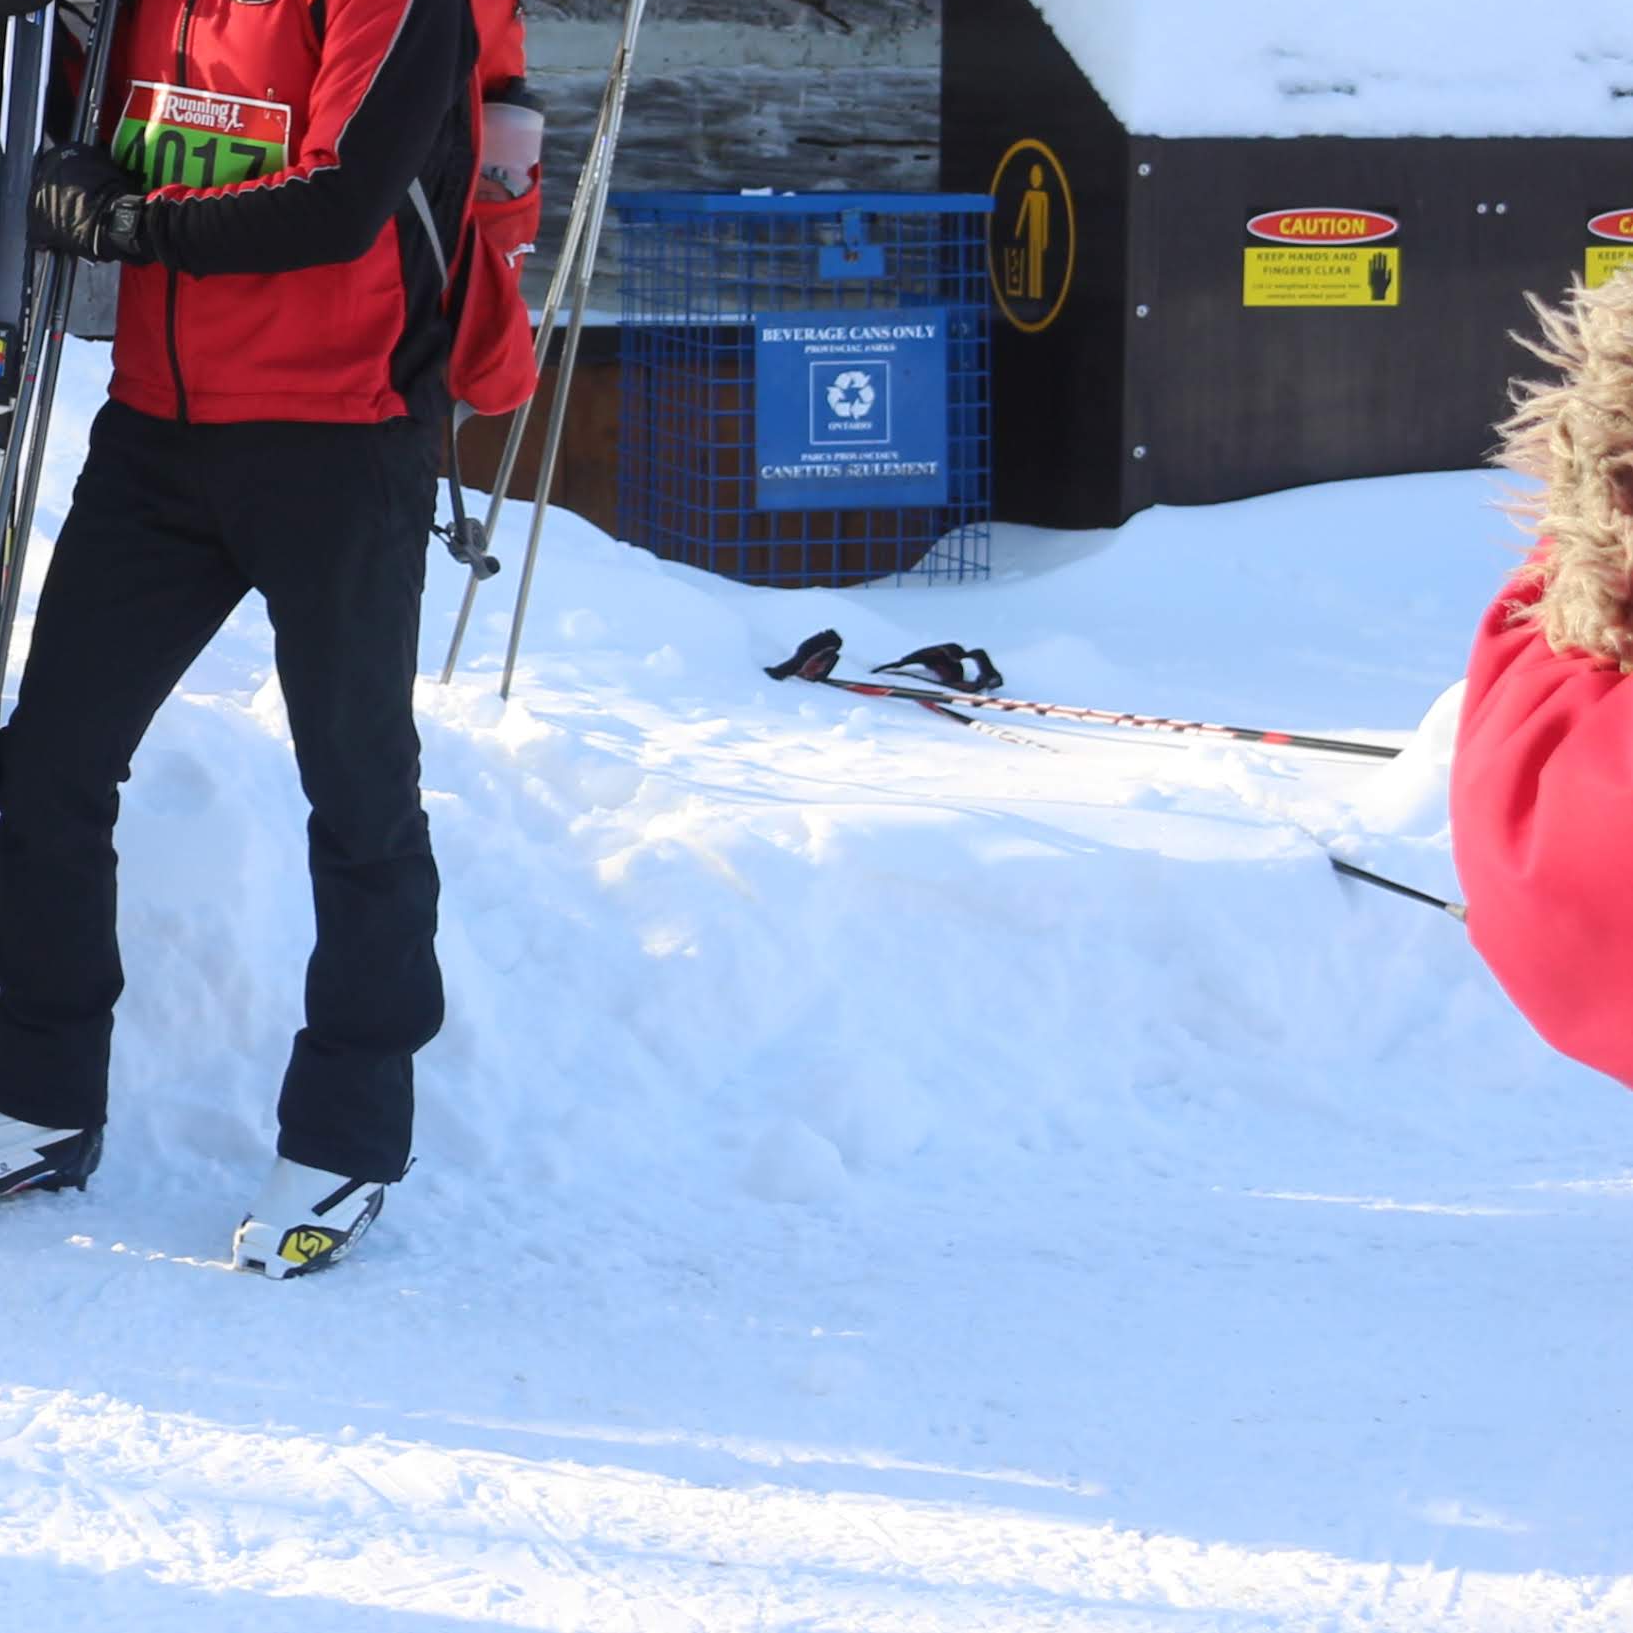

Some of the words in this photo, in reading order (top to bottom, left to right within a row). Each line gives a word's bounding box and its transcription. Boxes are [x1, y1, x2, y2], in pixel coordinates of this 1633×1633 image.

[163, 93, 230, 127] Running
[126, 125, 267, 187] 4017
[1279, 217, 1366, 235] CAUTION
[1257, 252, 1284, 261] KEEP
[1288, 252, 1328, 261] HANDS
[1332, 252, 1358, 261] AND
[1263, 266, 1312, 275] FINGERS
[1315, 266, 1351, 275] CLEAR
[762, 327, 846, 342] BEVERAGE
[849, 326, 891, 340] CANS
[892, 325, 936, 340] ONLY
[827, 421, 873, 431] ONTARIO
[761, 463, 842, 479] CANETTES
[846, 461, 938, 477] SEULEMENT
